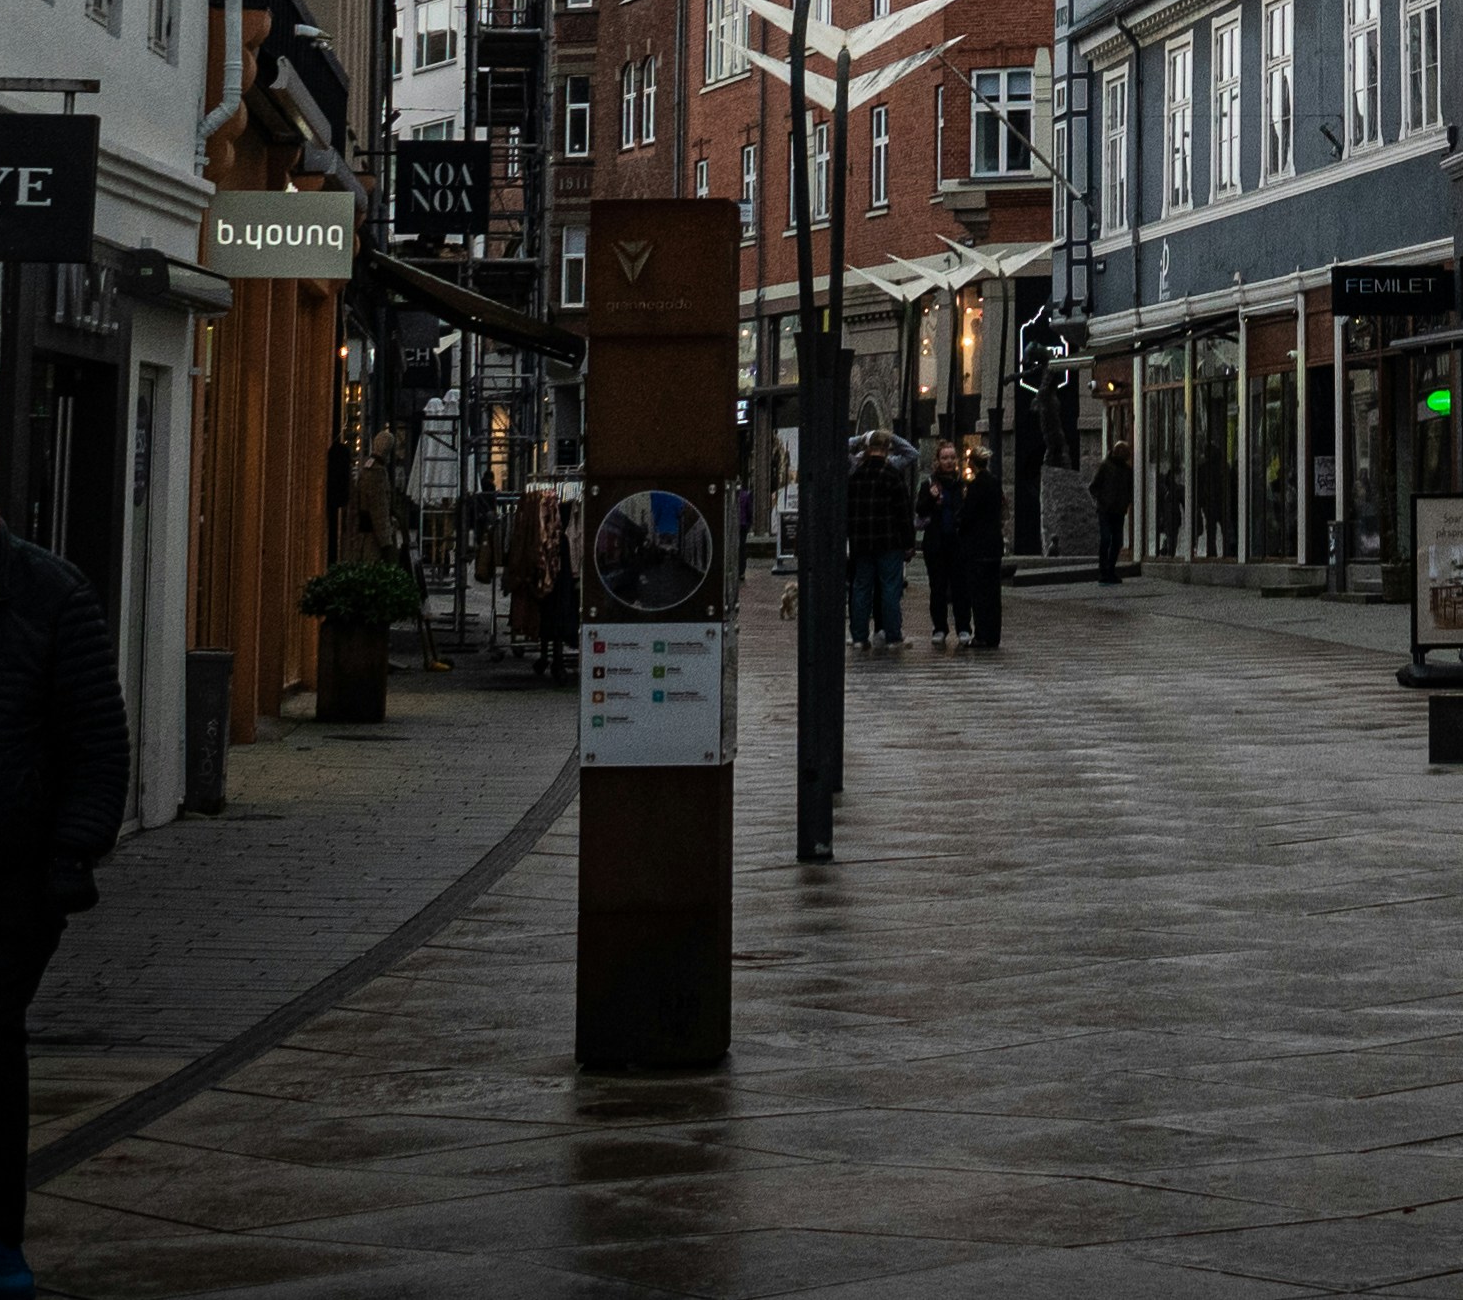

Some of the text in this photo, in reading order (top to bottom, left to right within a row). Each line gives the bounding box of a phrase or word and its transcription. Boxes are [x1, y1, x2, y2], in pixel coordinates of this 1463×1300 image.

[410, 161, 474, 187] NOA
[410, 187, 474, 213] NOA
[216, 218, 345, 252] b.young
[1345, 277, 1438, 294] FEMILET
